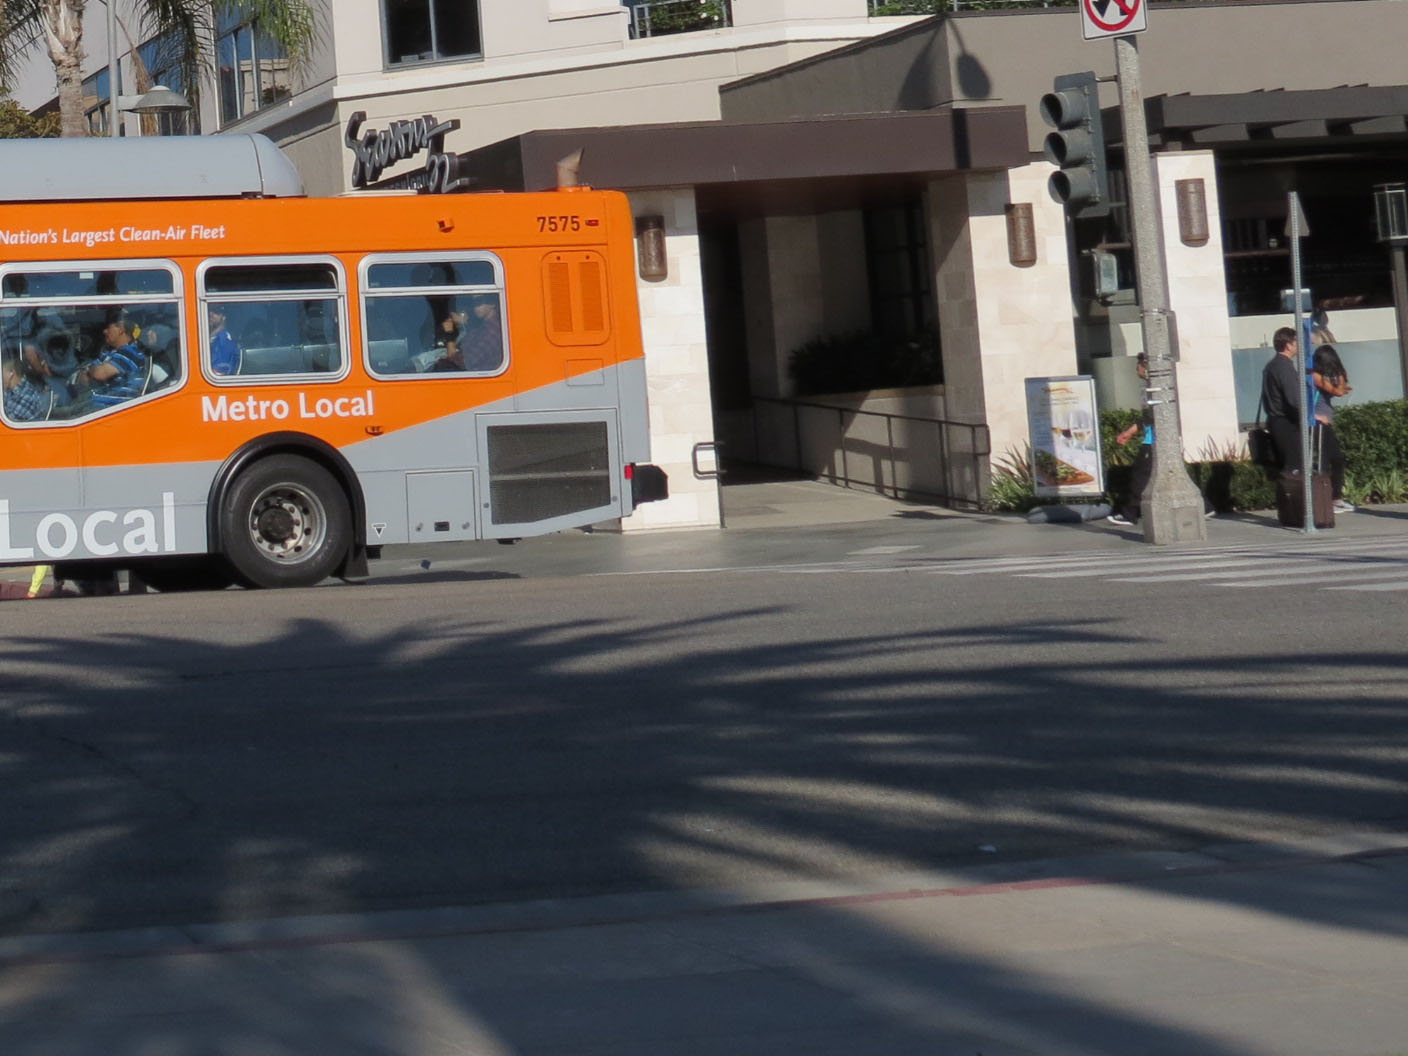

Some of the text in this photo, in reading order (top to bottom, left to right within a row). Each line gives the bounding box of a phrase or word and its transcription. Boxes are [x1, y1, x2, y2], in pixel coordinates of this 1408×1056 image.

[536, 215, 580, 232] 7575
[62, 228, 115, 247] Largest
[120, 226, 186, 242] Clean-Air
[191, 225, 225, 239] Fleet
[201, 390, 374, 422] Metro Local
